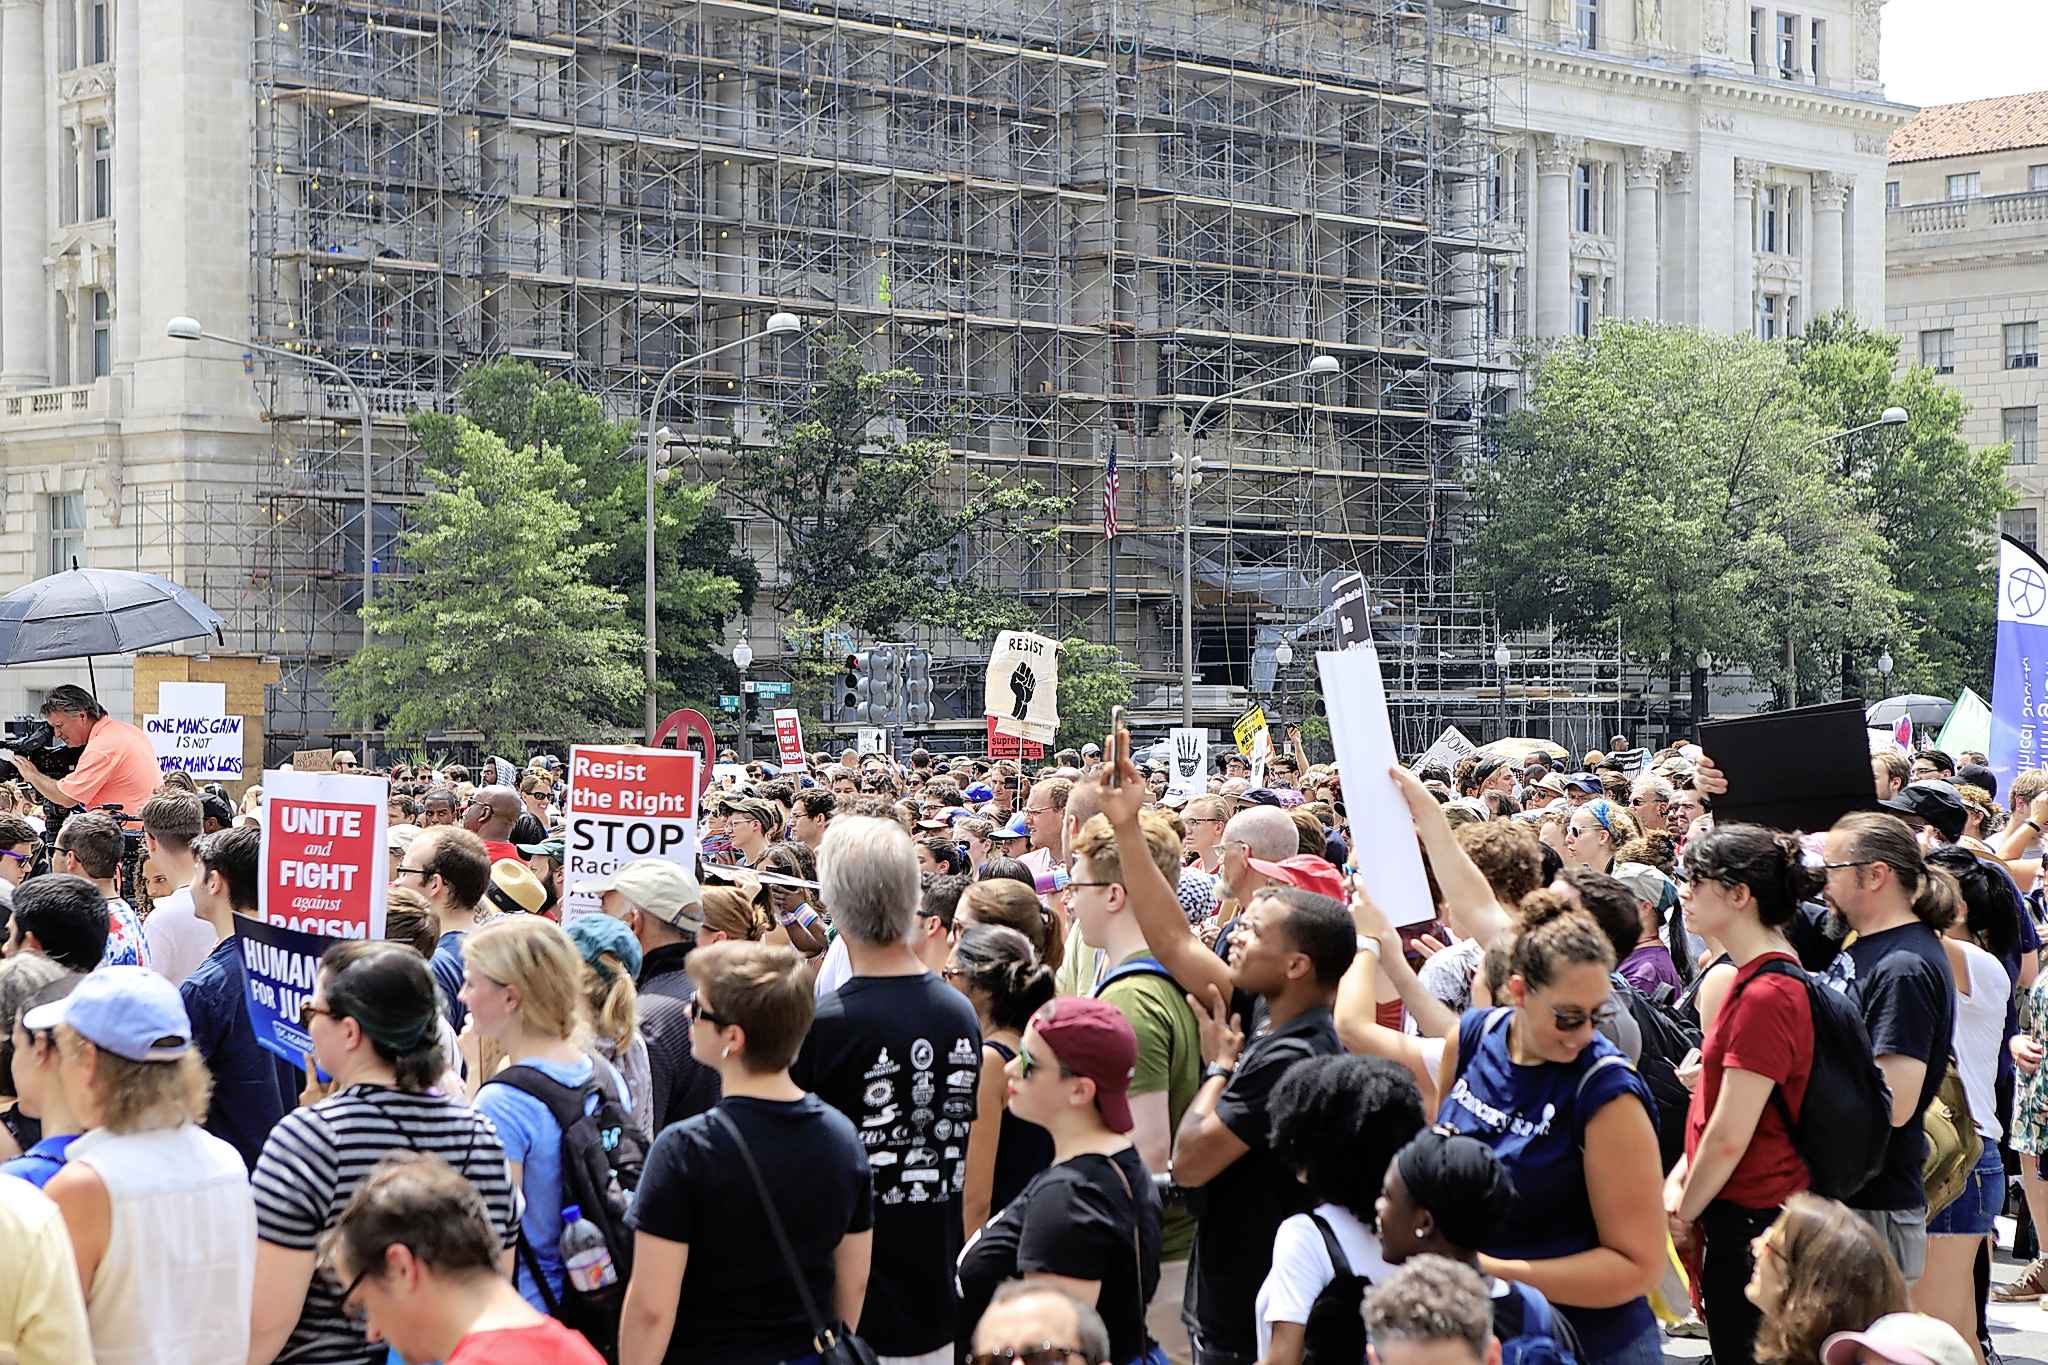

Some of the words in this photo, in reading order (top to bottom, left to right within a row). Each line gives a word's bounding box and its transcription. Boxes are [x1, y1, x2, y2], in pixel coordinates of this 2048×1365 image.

[1009, 638, 1044, 656] RESIST
[147, 718, 174, 734] ONE
[176, 716, 209, 734] MAN'S
[210, 718, 240, 734] GAIN
[176, 736, 190, 749] IS
[192, 737, 213, 749] NOT
[183, 753, 216, 773] MAN'S
[216, 755, 243, 774] LOSS
[574, 756, 647, 782] Resist
[572, 786, 612, 809] the
[619, 790, 685, 816] Right
[281, 806, 362, 838] UNITE
[304, 840, 333, 857] and
[572, 819, 685, 856] STOP
[279, 860, 359, 891] FIGHT
[292, 894, 342, 912] against
[250, 979, 277, 1010] FOR
